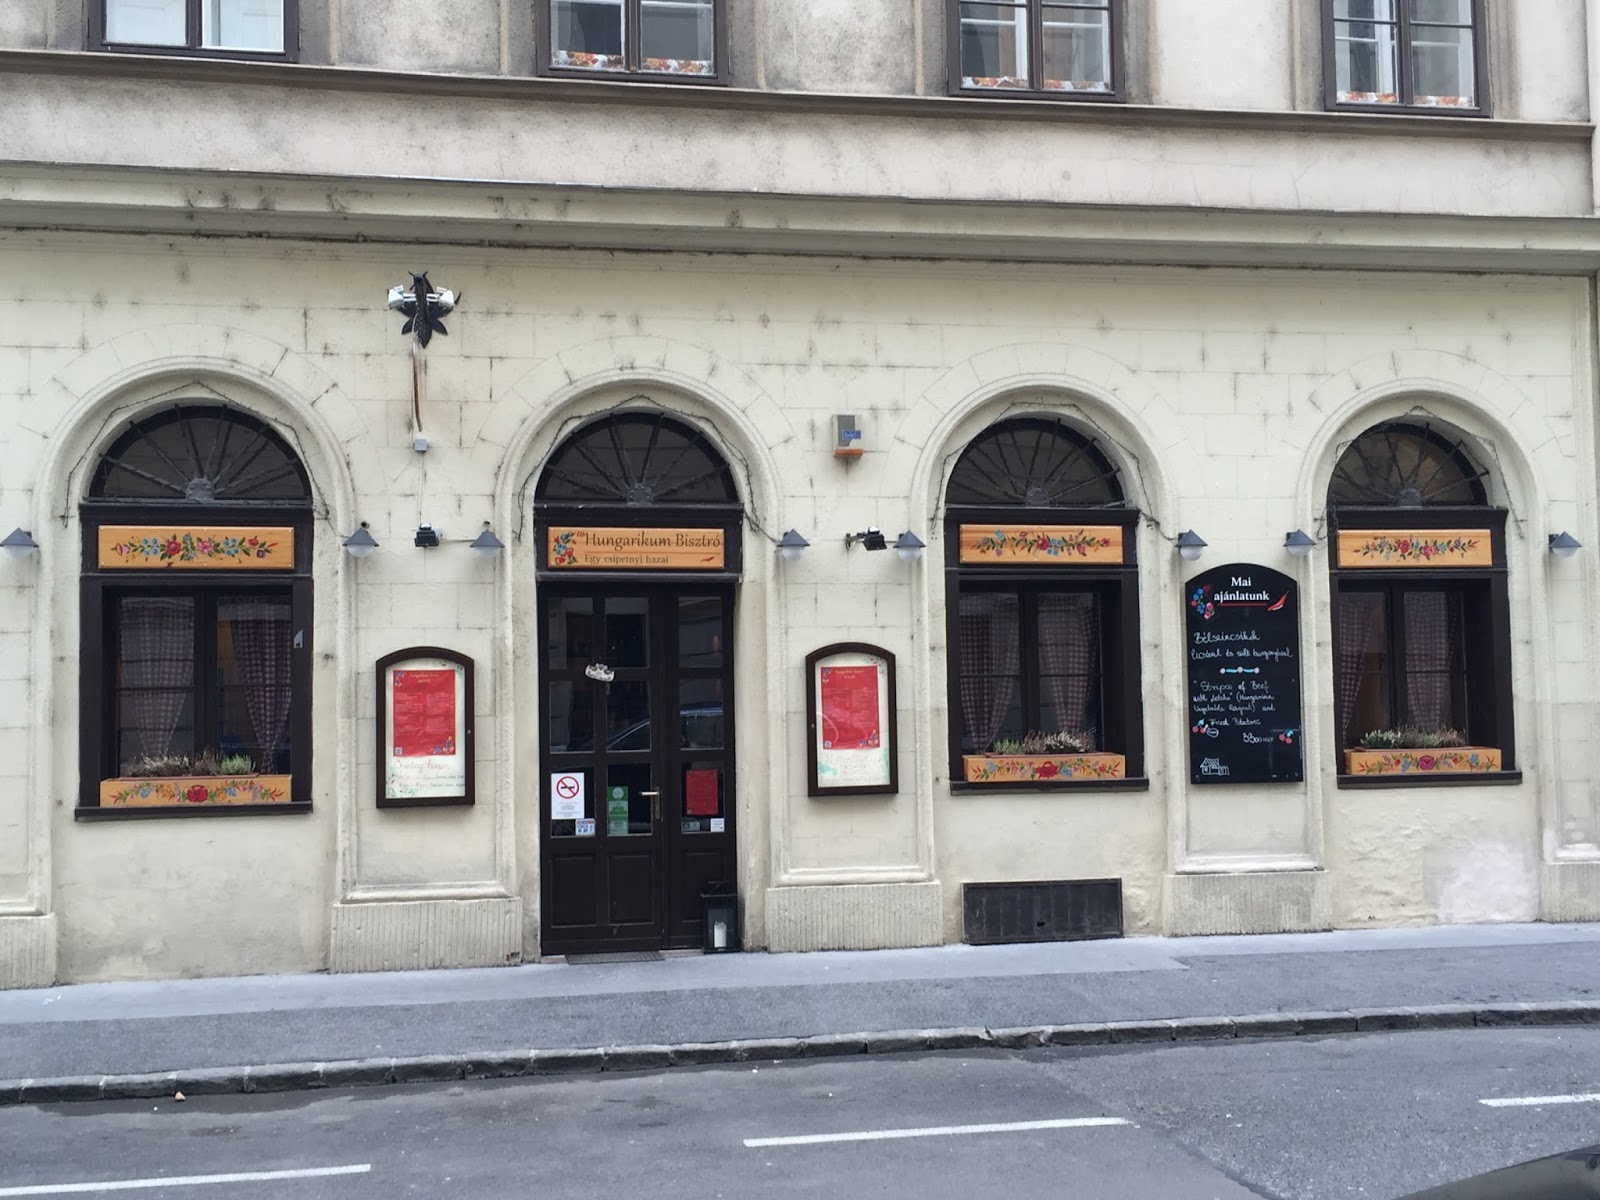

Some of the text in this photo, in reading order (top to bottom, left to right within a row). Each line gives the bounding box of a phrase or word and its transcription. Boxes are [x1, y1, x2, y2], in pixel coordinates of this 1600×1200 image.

[585, 532, 721, 551] Hungarikum Bisztró
[584, 554, 669, 565] Egy csipetnyi hazai
[1230, 576, 1252, 587] Mai
[1213, 590, 1270, 604] ajánlatunk
[1237, 680, 1246, 693] of
[1250, 680, 1270, 694] Beef
[1208, 717, 1230, 726] Fried
